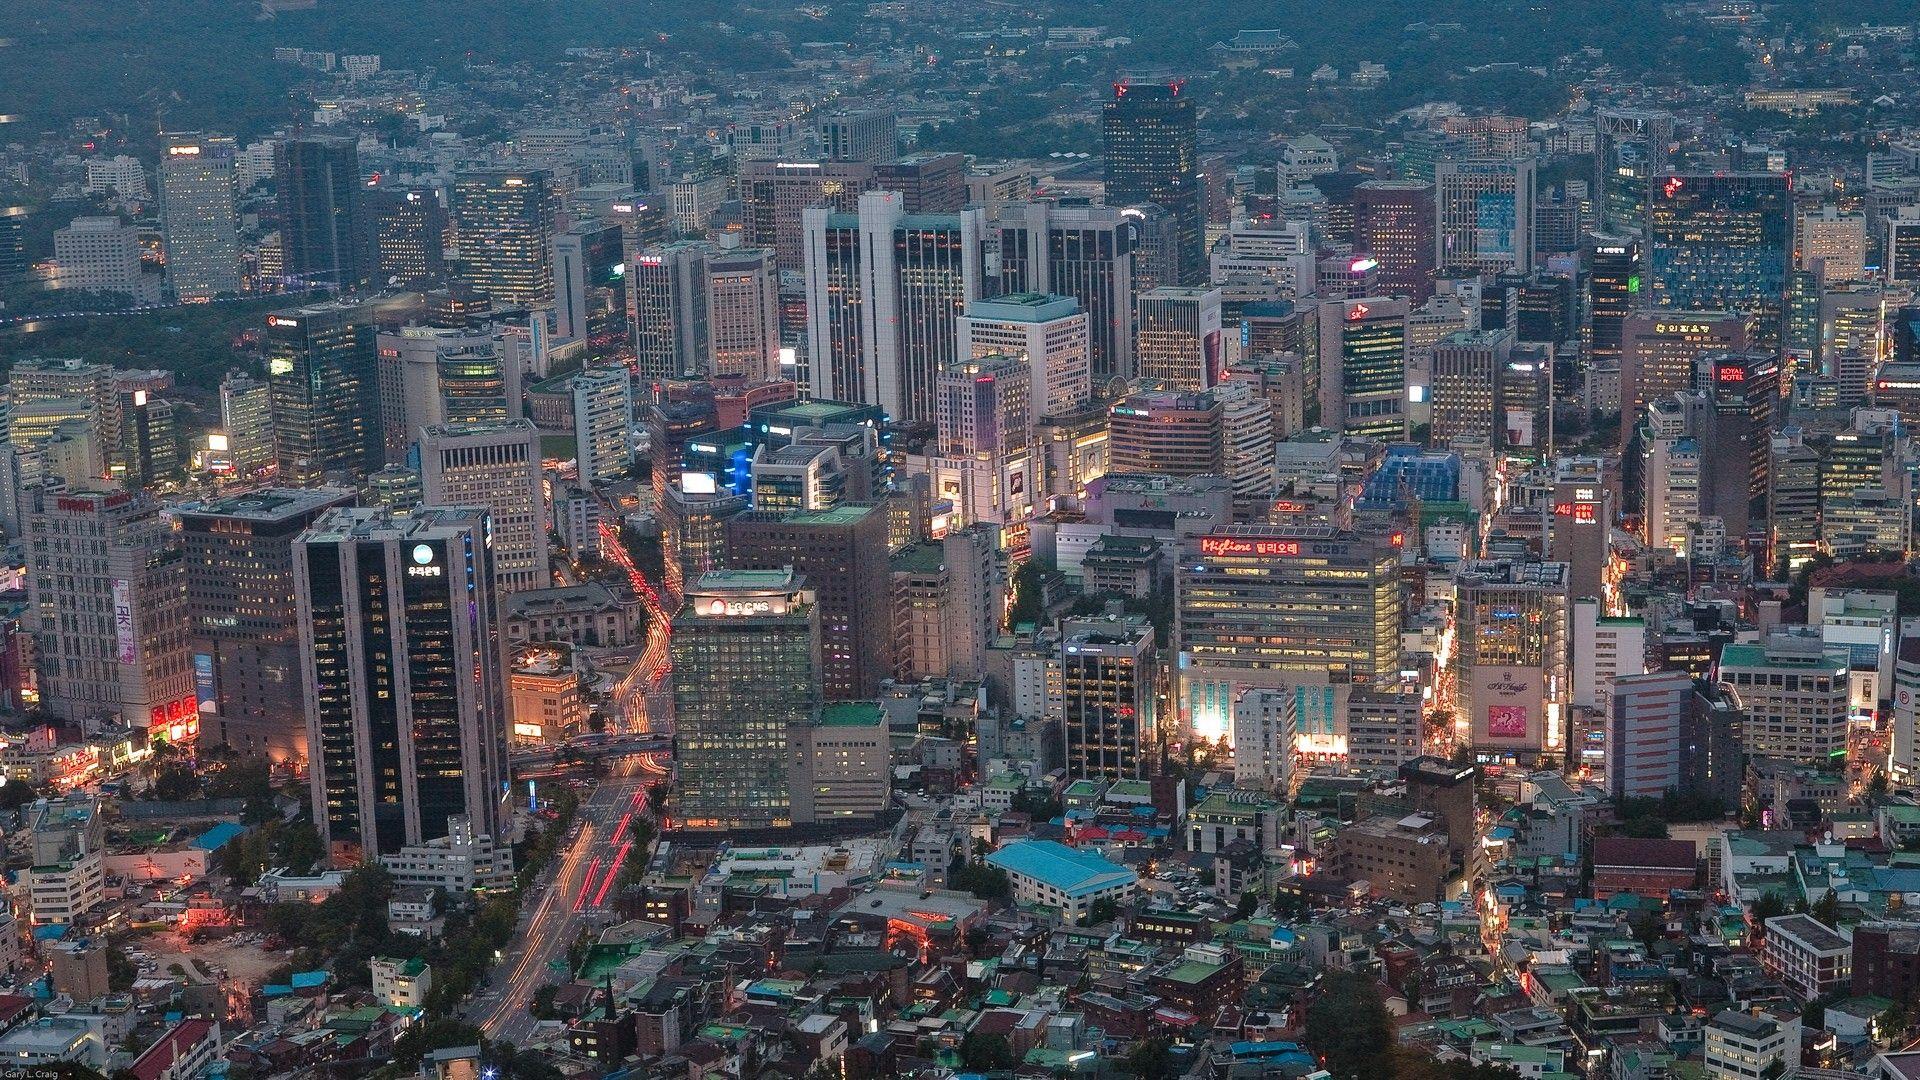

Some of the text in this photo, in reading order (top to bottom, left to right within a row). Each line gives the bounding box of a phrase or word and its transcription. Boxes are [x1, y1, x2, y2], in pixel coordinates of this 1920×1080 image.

[1351, 312, 1362, 320] SK
[1721, 367, 1744, 375] ROYAL
[1202, 539, 1251, 556] Migliore
[1256, 543, 1298, 554] 밀리오레
[408, 566, 441, 577] 우리은행
[744, 600, 769, 611] CNS
